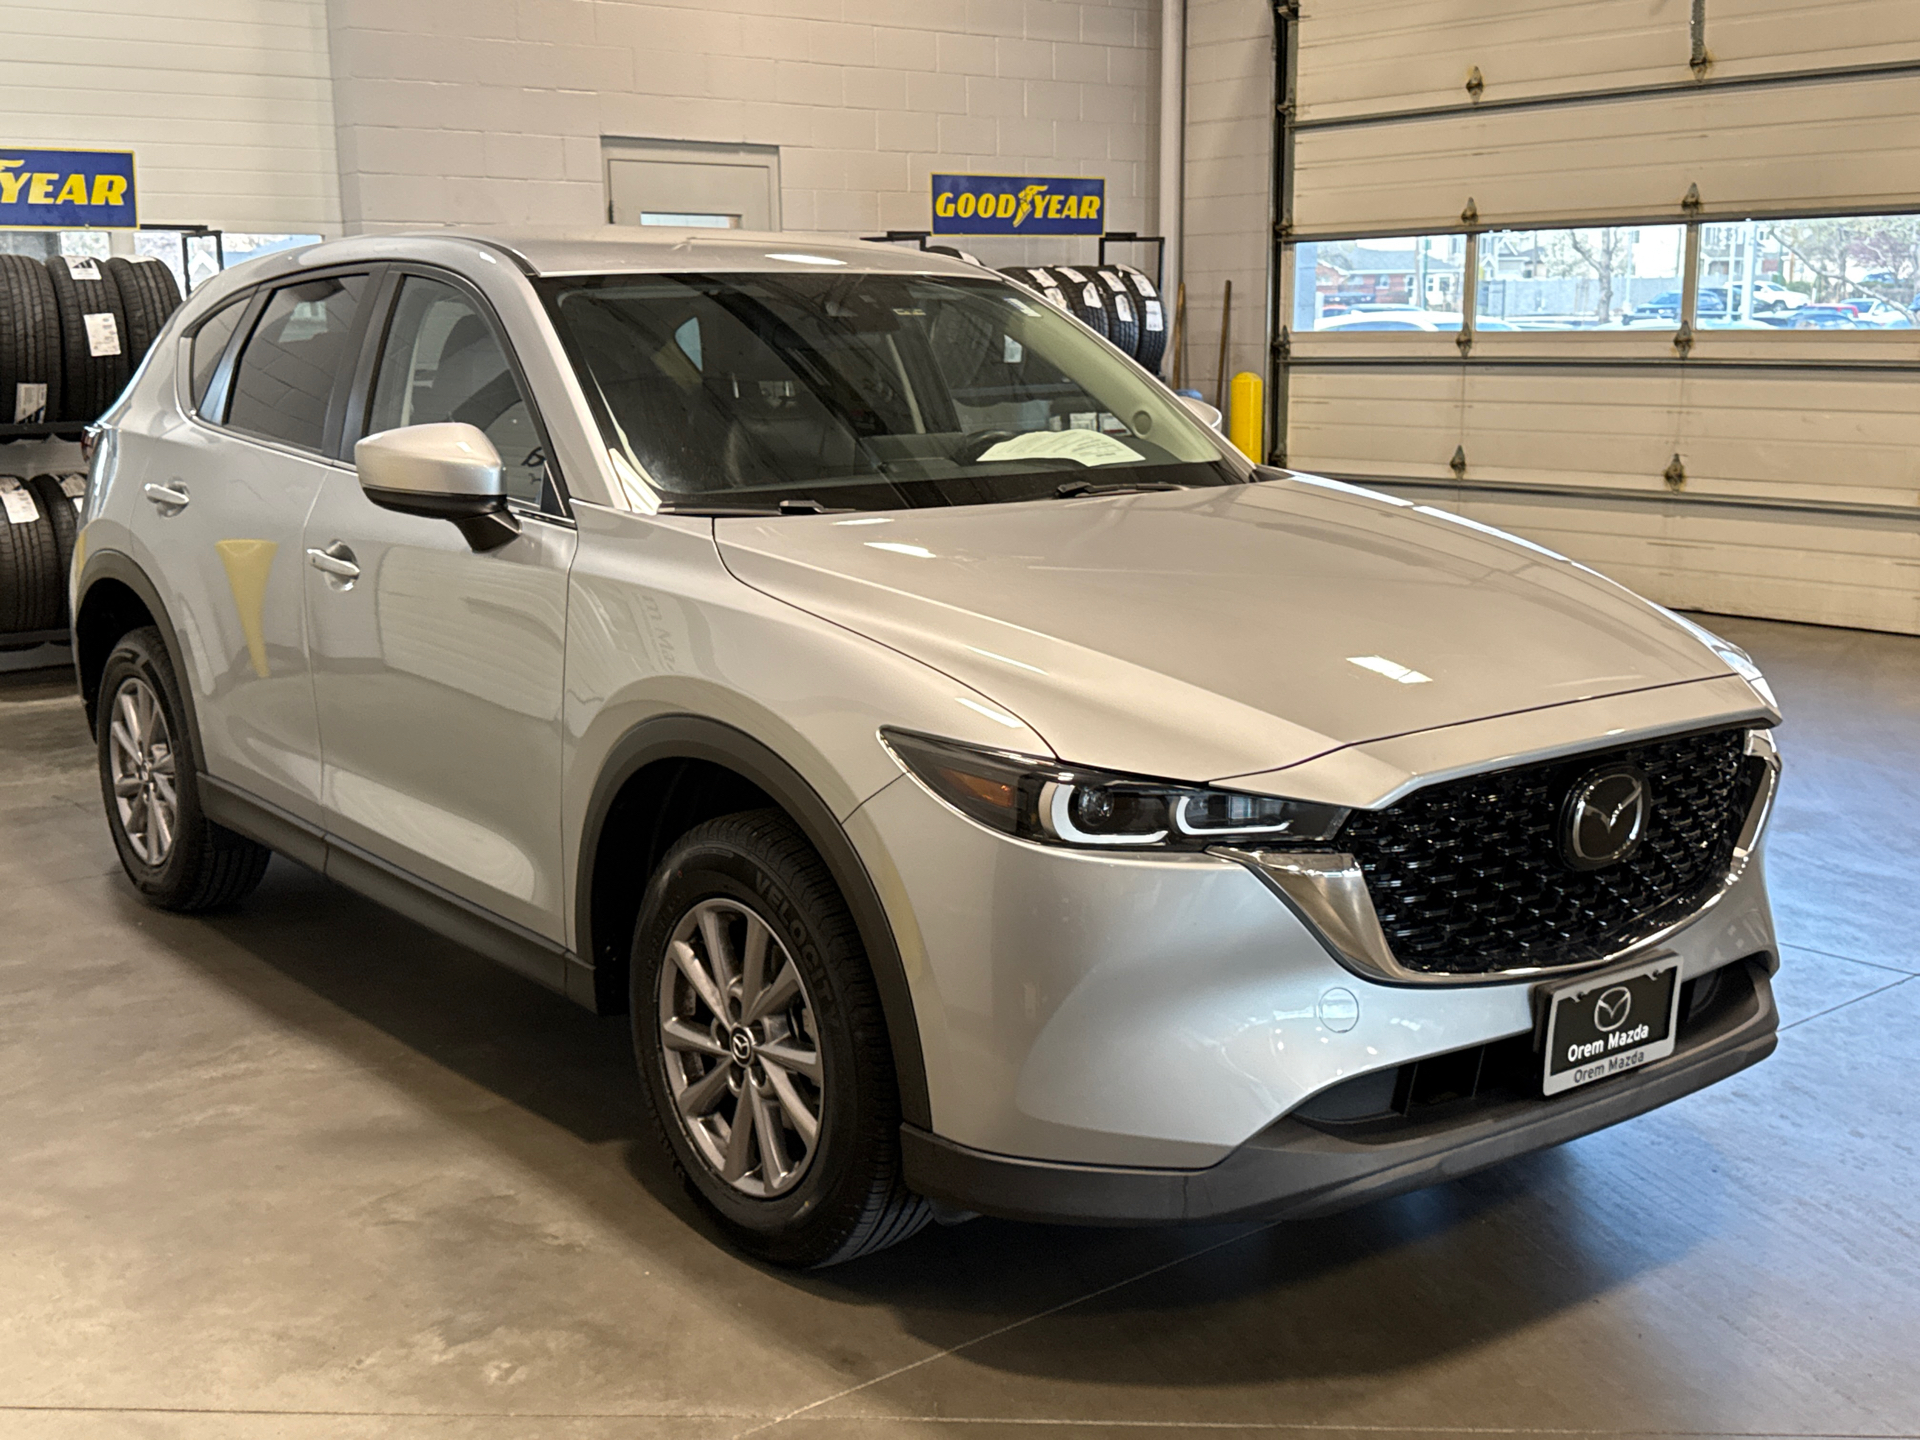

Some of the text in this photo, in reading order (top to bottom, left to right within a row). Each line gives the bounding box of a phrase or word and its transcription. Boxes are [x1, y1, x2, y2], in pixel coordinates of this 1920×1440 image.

[0, 172, 127, 205] YEAR
[1567, 1024, 1649, 1061] Orem Mazda
[1574, 1051, 1645, 1083] Orem Mazda
